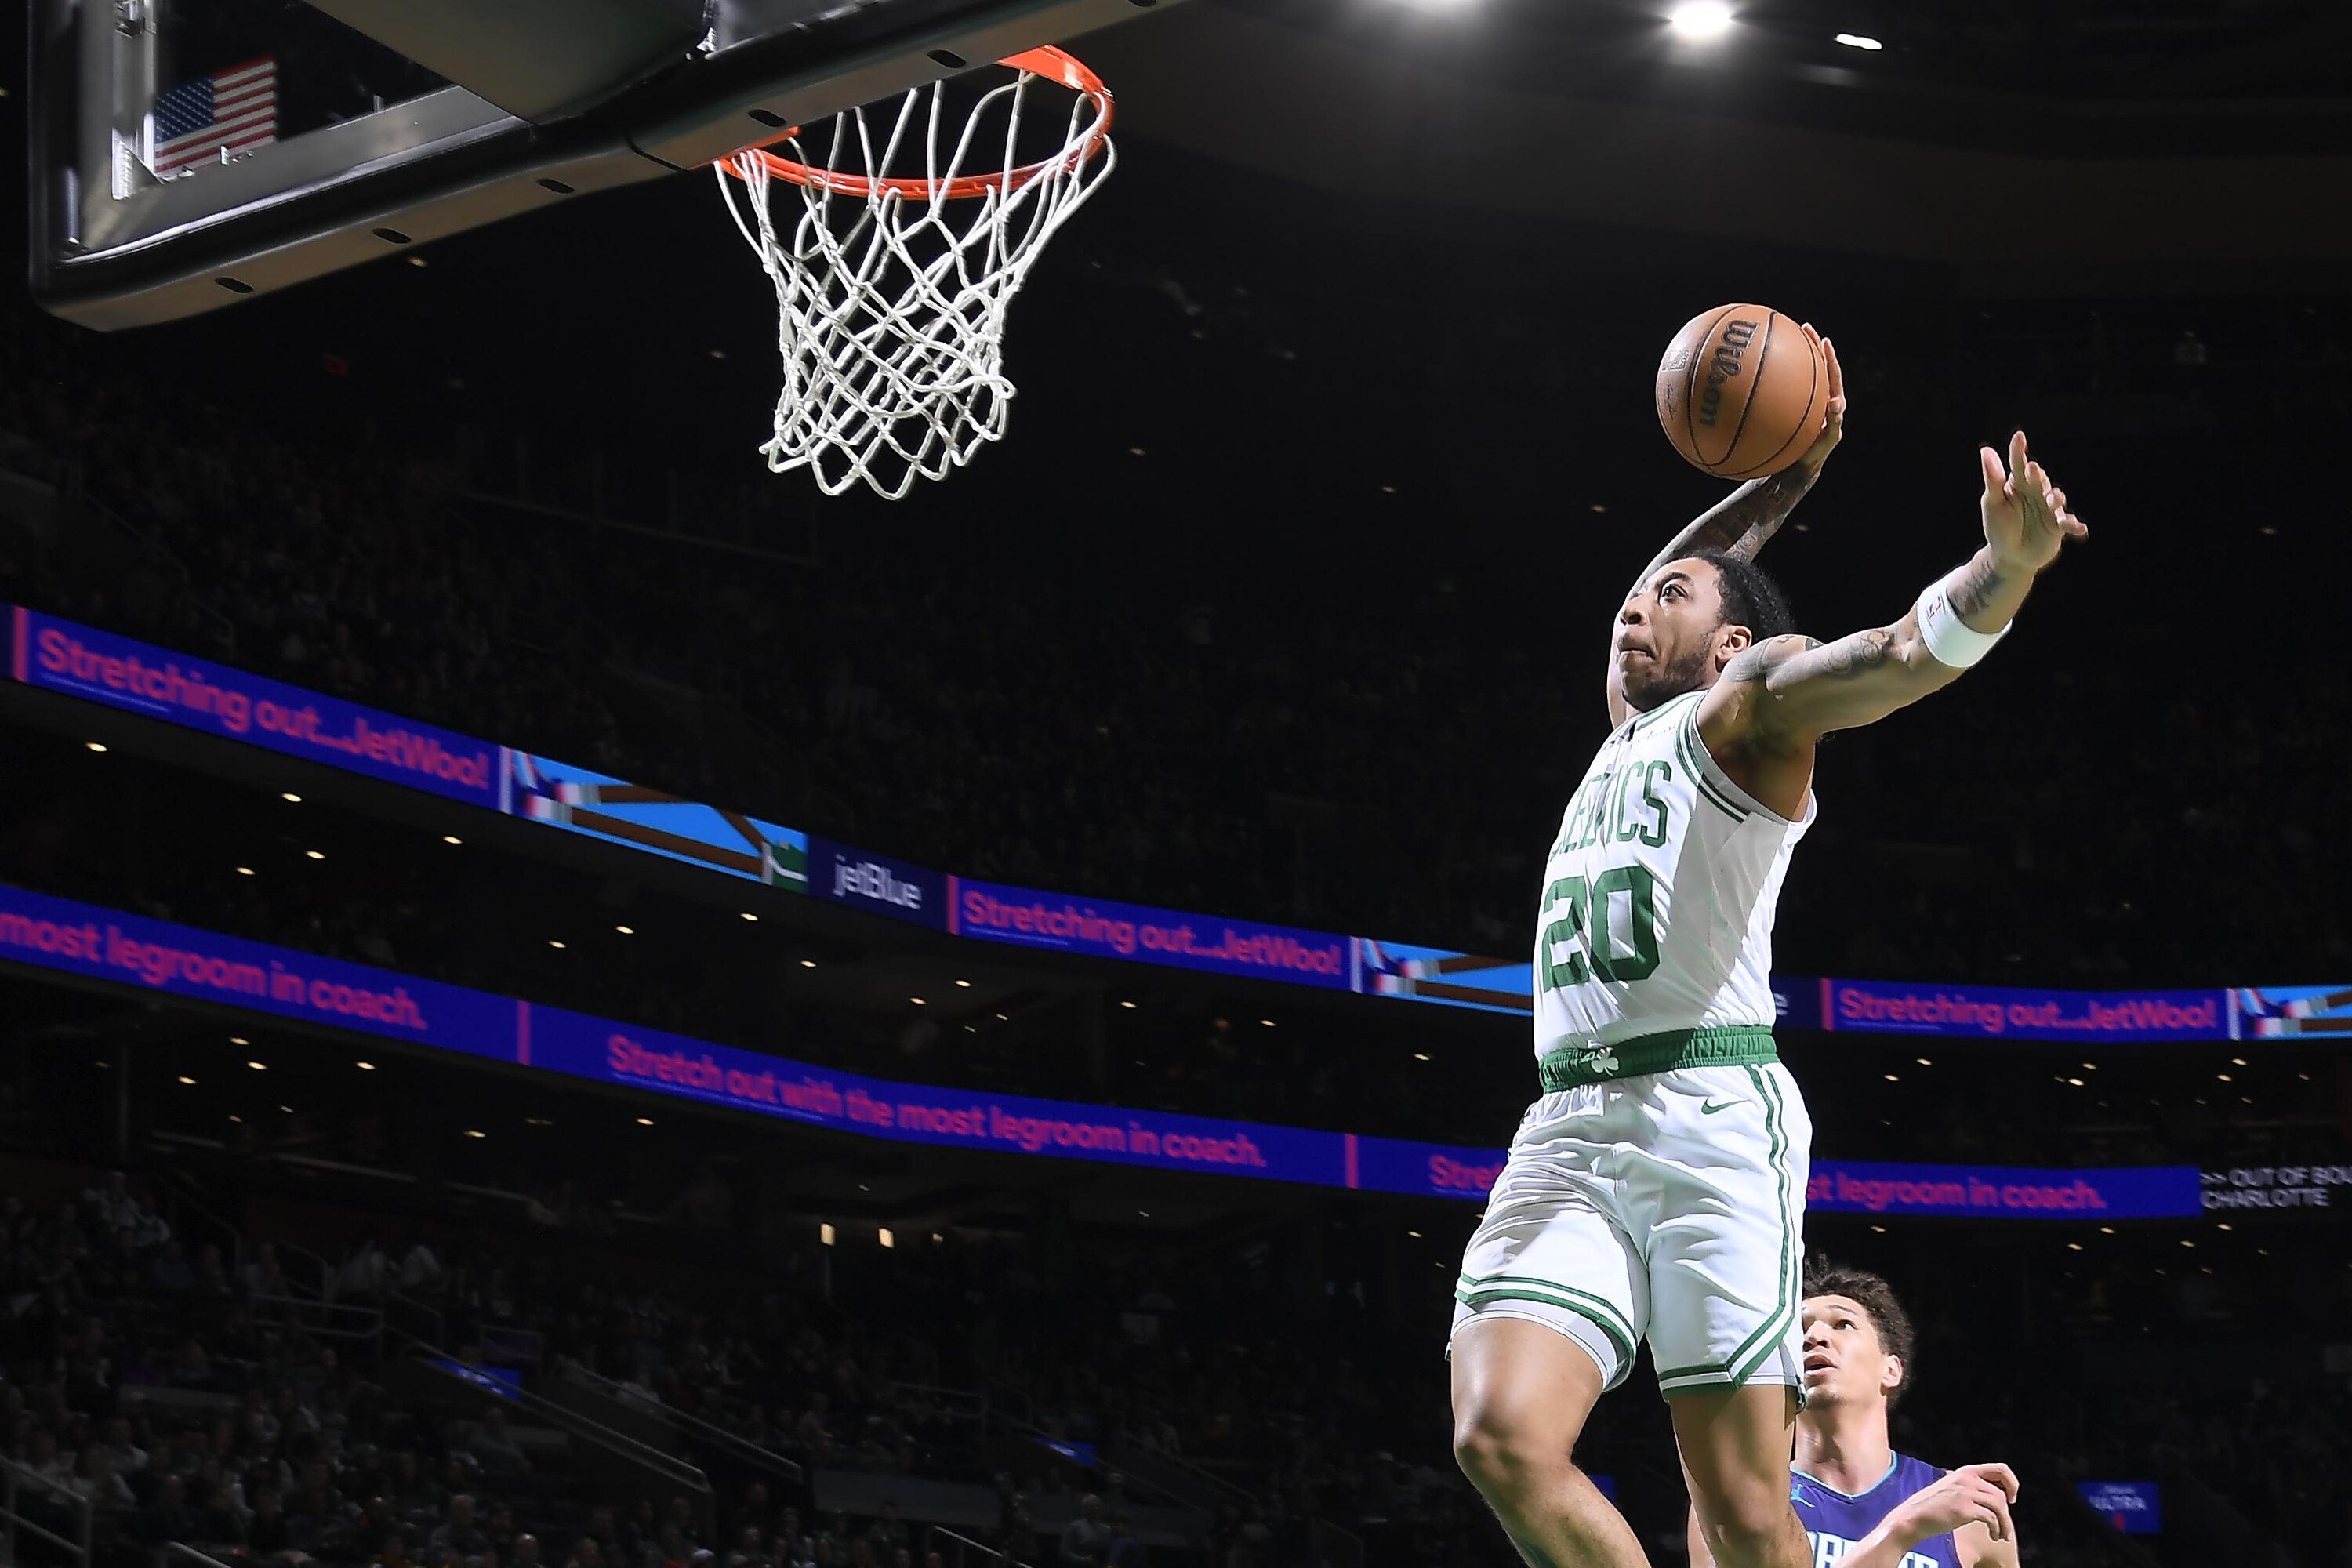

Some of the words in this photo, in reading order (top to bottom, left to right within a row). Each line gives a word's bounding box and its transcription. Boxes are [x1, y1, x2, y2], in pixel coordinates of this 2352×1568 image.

[1700, 319, 1761, 427] Wilson
[39, 630, 250, 733] Stretching
[833, 852, 923, 910] jetBlue
[964, 891, 1136, 955] Stretching
[1543, 865, 1661, 993] 20
[0, 913, 101, 963] most
[107, 925, 267, 996] legroom
[272, 961, 306, 1004] in
[310, 980, 427, 1029] coach.
[1840, 988, 2005, 1033] Stretching
[608, 1034, 724, 1091] Stretch
[726, 1069, 777, 1104] out
[779, 1076, 844, 1117] with
[845, 1088, 895, 1127] the
[898, 1104, 987, 1137] most
[990, 1105, 1127, 1152] legroom
[1129, 1122, 1160, 1156] in
[1163, 1133, 1267, 1167] coach.
[1837, 1171, 1967, 1211] legroom
[1969, 1178, 1999, 1206] in
[2002, 1180, 2107, 1210] coach.
[2199, 1186, 2330, 1210] CHARLOTTE
[2229, 1167, 2274, 1188] OUT
[2278, 1166, 2310, 1186] OF
